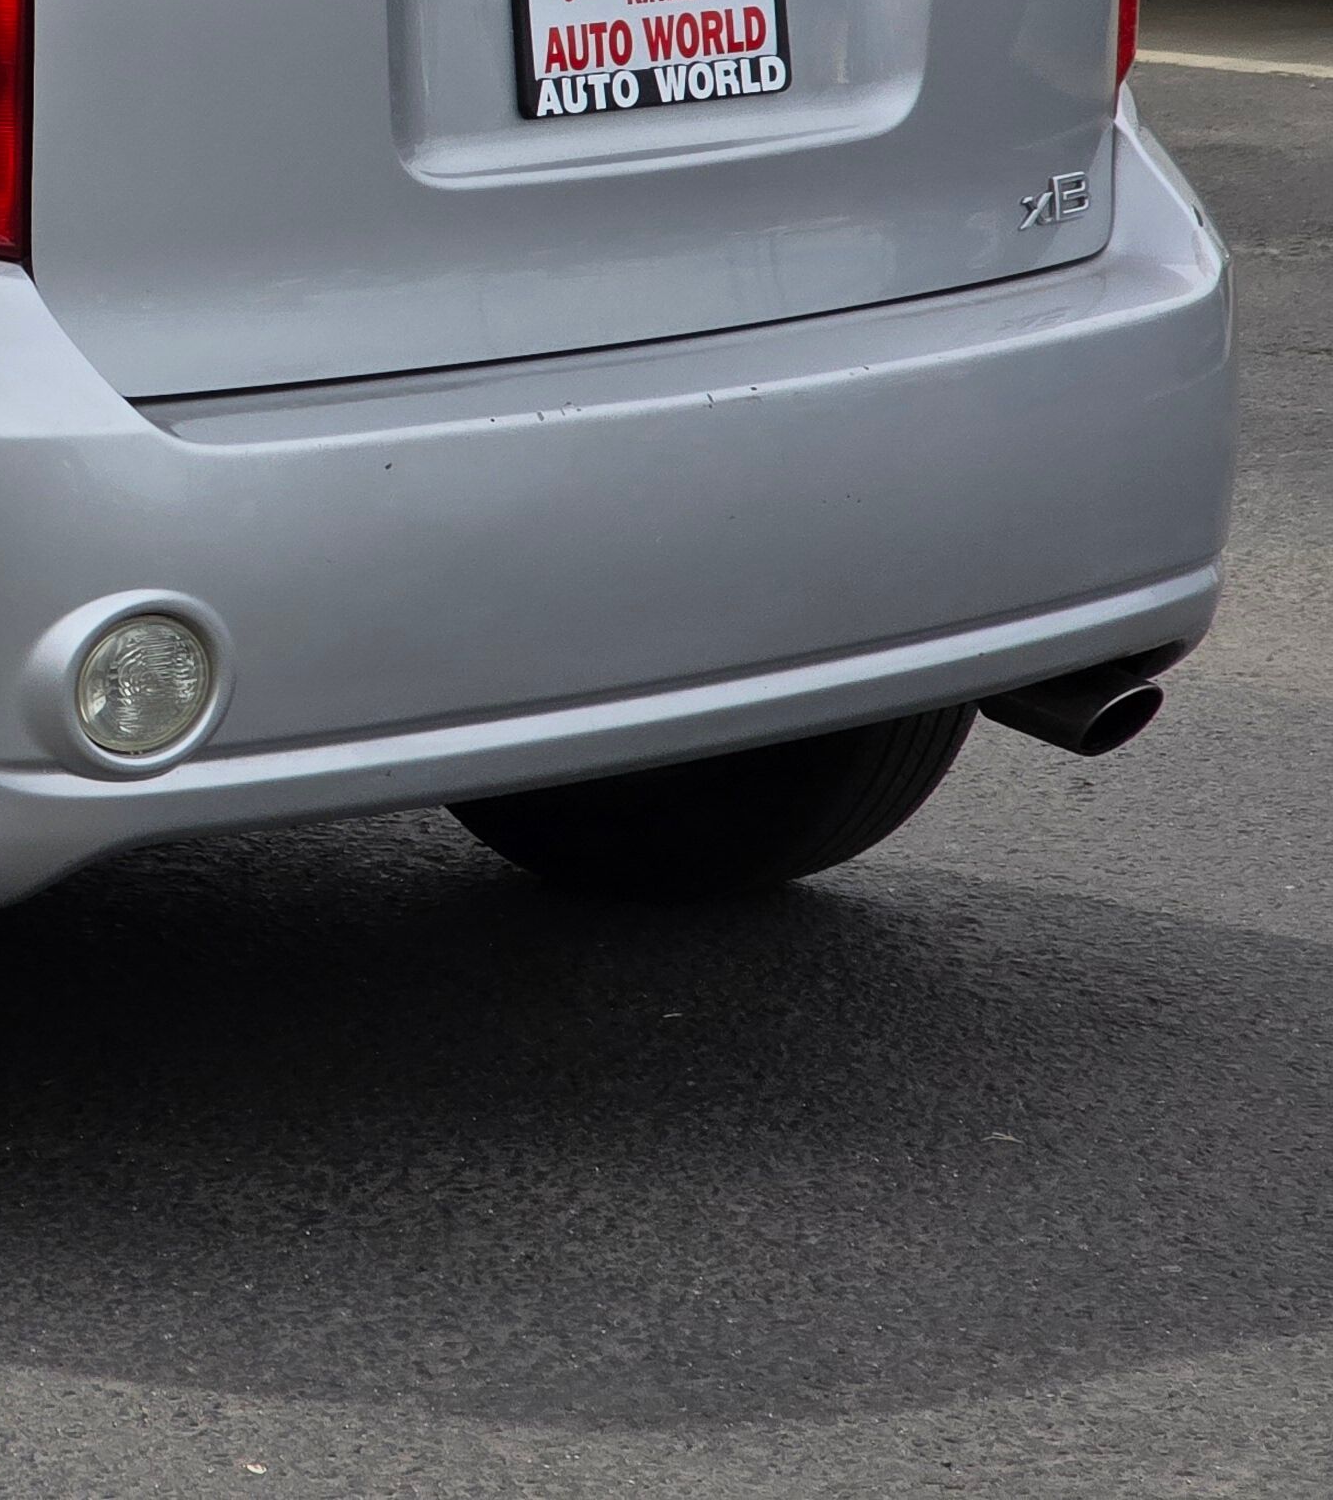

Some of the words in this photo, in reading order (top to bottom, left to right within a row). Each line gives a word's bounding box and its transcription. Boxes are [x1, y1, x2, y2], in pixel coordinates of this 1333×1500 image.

[544, 19, 634, 74] AUTO
[641, 5, 767, 63] WORLD
[536, 70, 640, 117] AUTO
[653, 55, 787, 104] WORLD
[1018, 171, 1090, 230] xB
